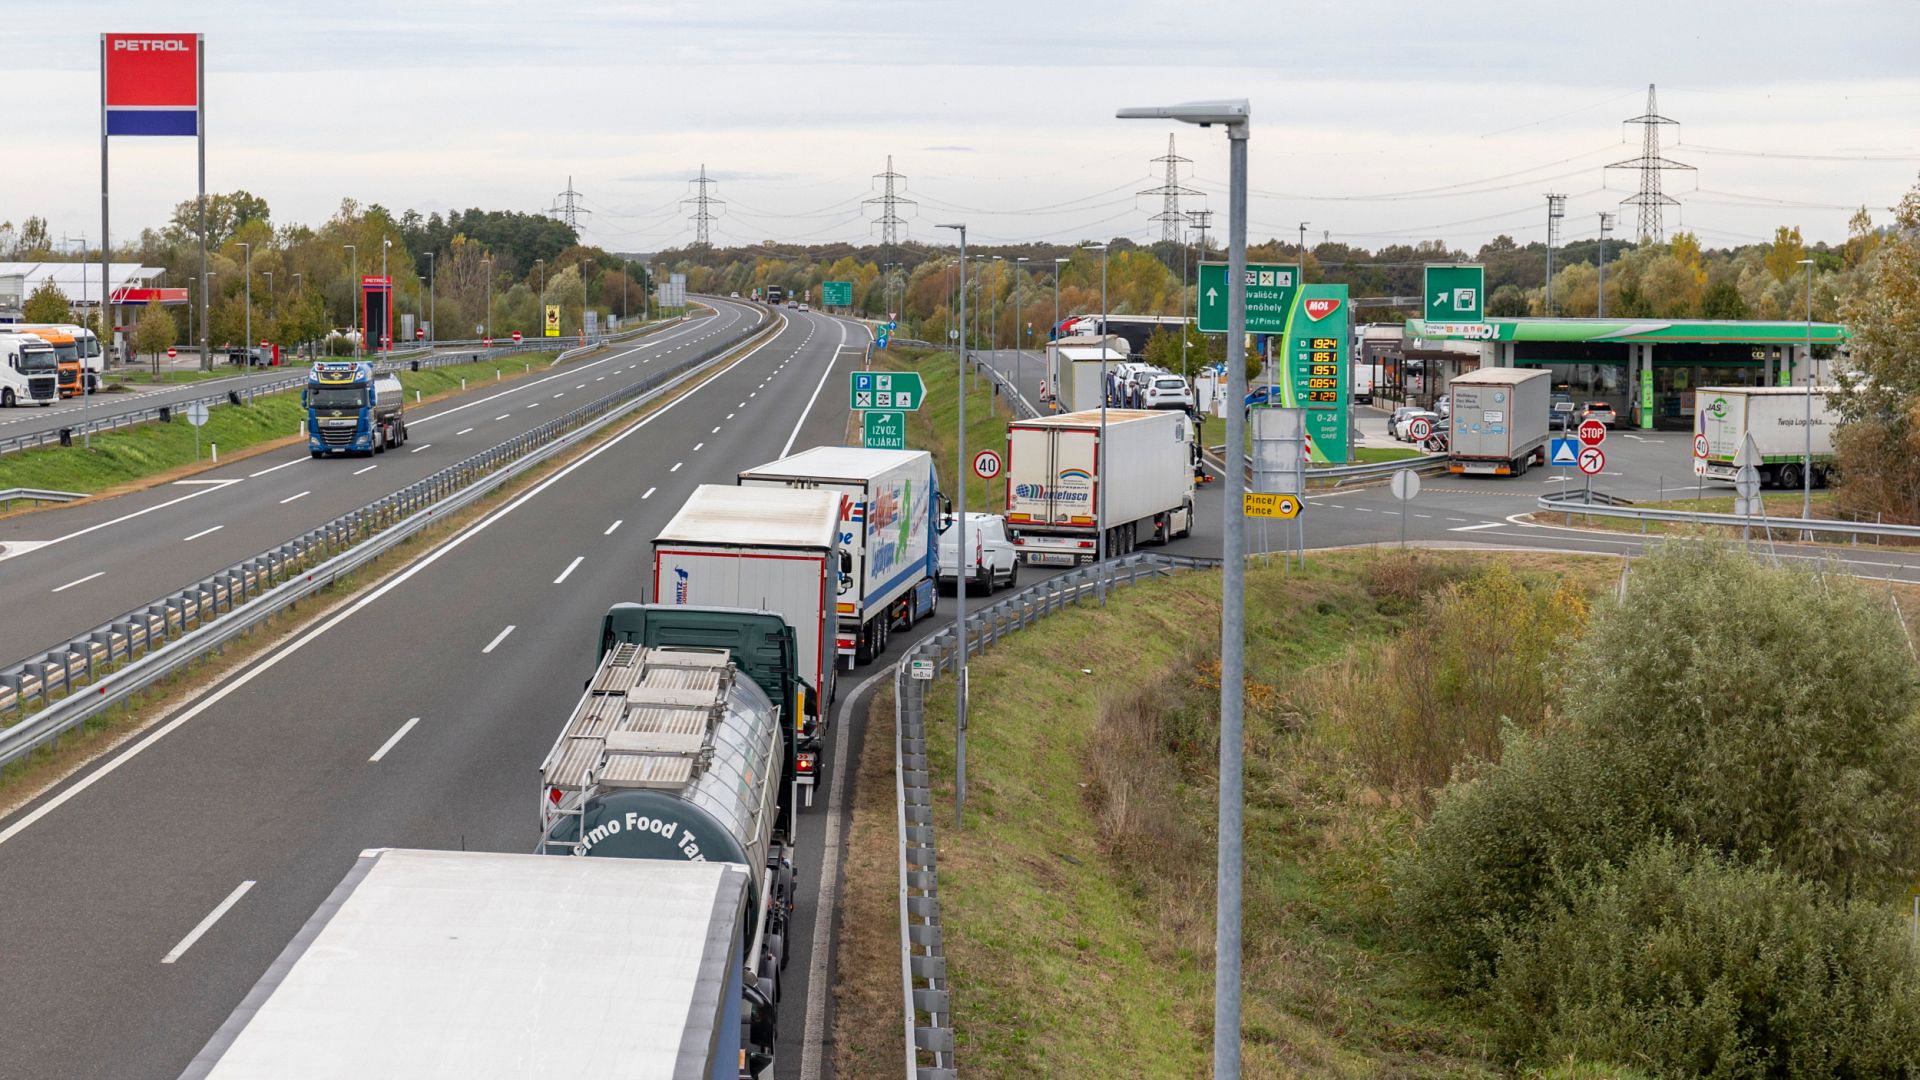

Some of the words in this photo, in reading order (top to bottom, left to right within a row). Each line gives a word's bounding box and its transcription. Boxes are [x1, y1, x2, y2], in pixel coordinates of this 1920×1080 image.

[114, 40, 190, 51] PETROL
[1308, 301, 1329, 311] MOL
[859, 376, 869, 388] P
[1317, 414, 1338, 422] 0-24
[872, 426, 897, 435] IZVOZ
[1414, 424, 1427, 435] 40
[1581, 427, 1603, 439] STOP
[867, 436, 901, 447] KIJÁRAT
[1696, 440, 1706, 454] 40
[979, 458, 996, 473] 40
[1245, 505, 1272, 515] Pince
[625, 812, 678, 839] Food
